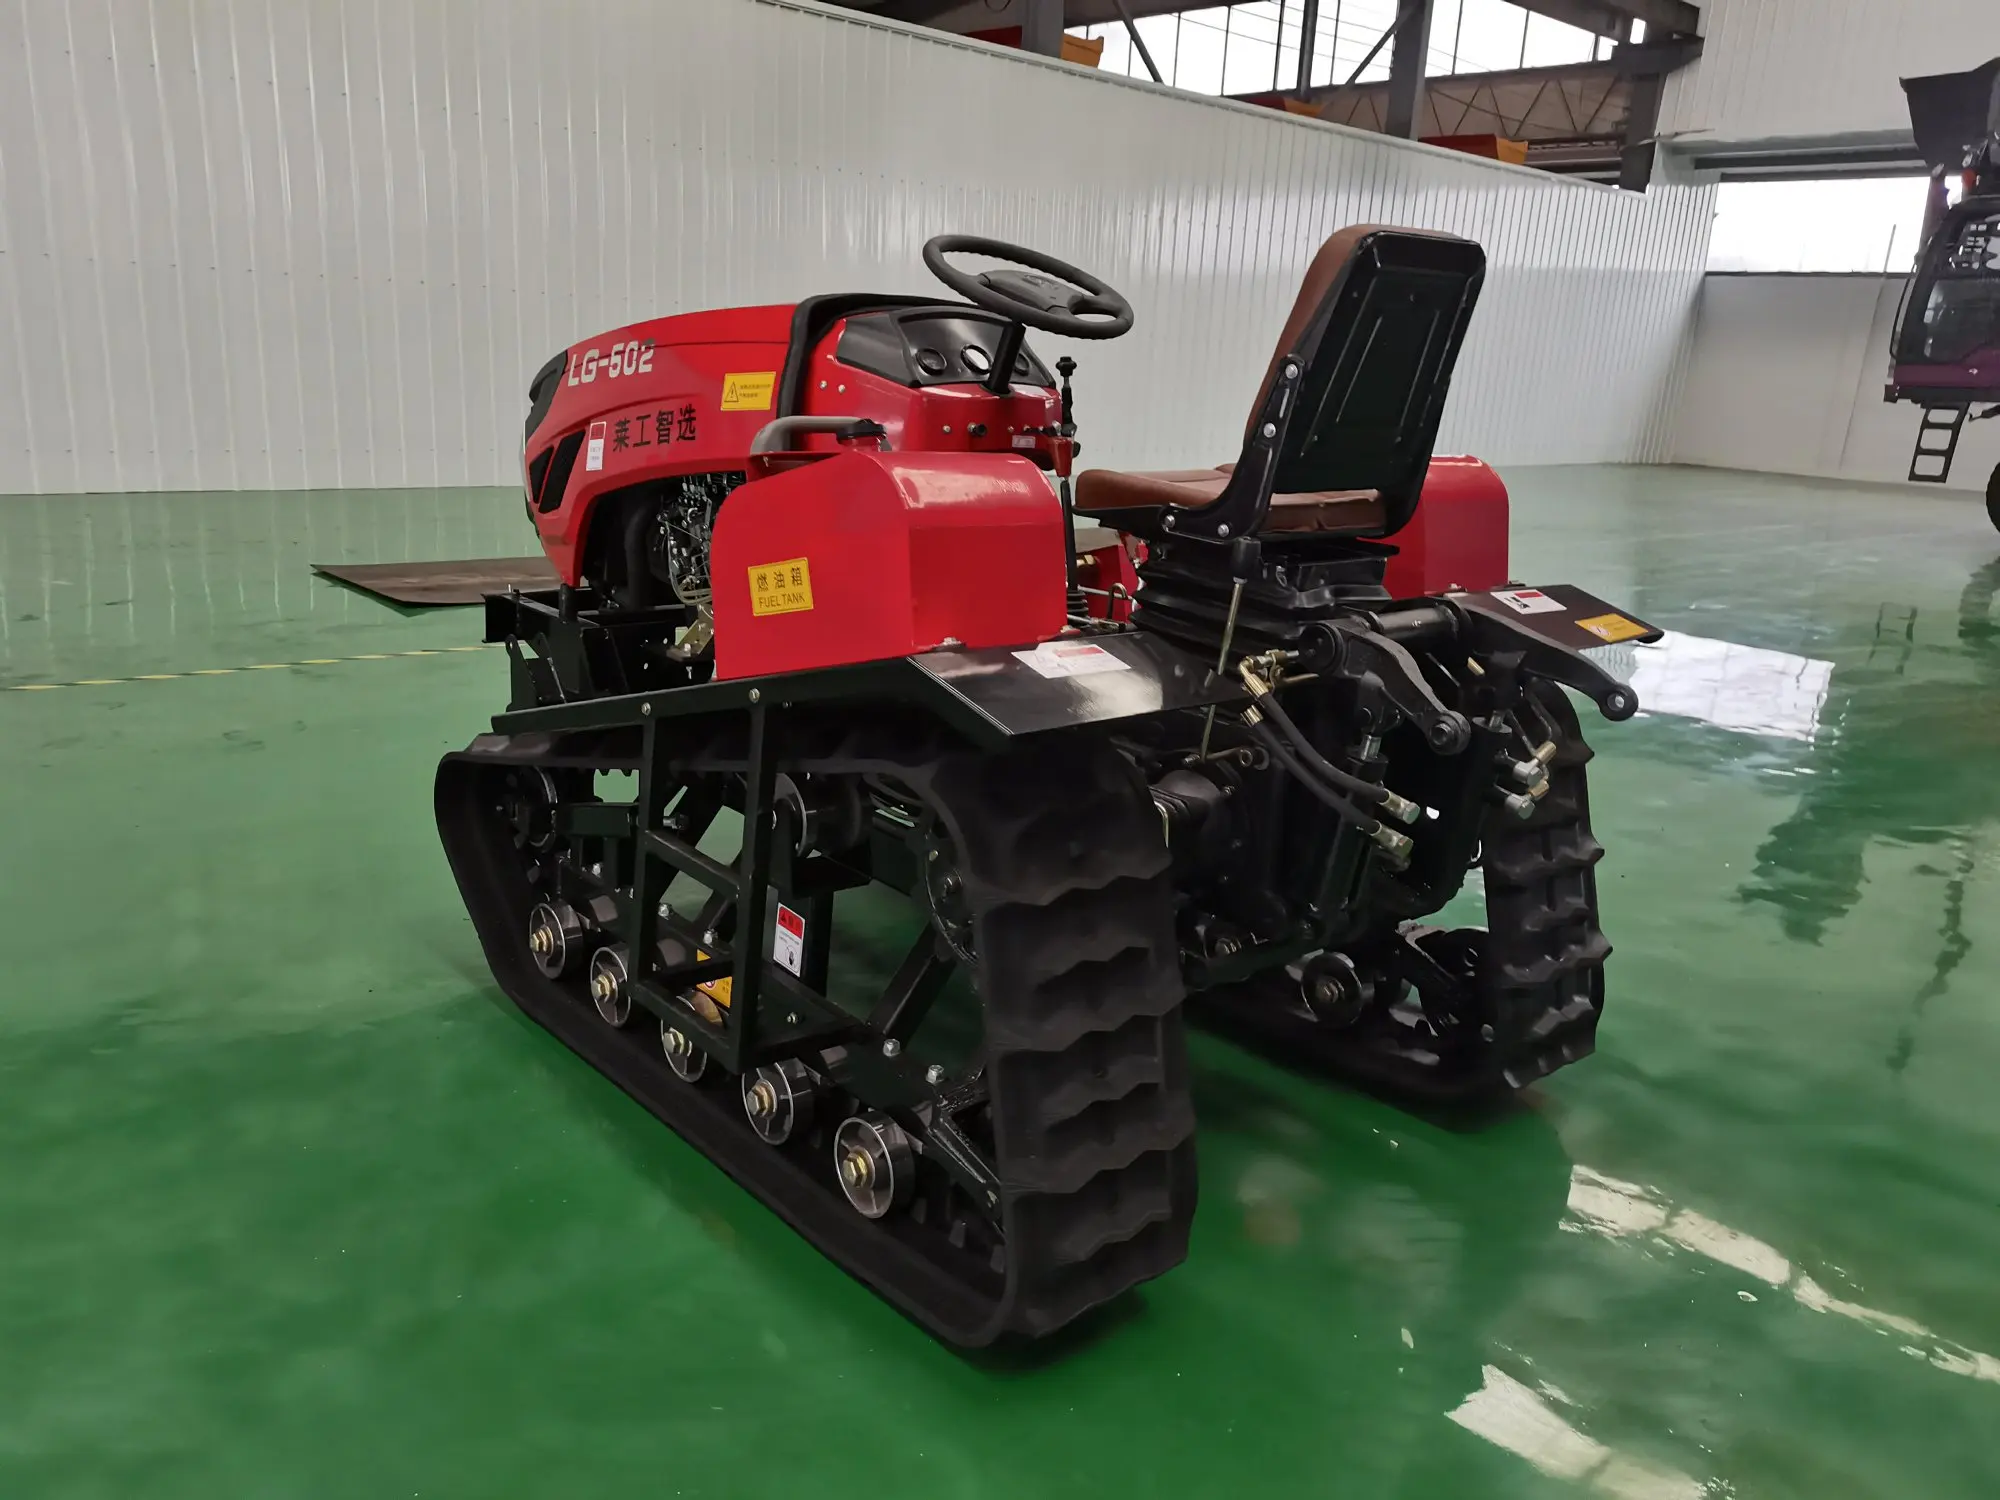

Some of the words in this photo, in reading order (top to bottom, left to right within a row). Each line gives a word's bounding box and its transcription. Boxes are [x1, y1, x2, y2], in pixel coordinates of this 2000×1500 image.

[568, 338, 656, 387] LG-502
[613, 404, 697, 452] 莱工智选
[758, 596, 781, 608] FUEL
[782, 592, 805, 605] TANK
